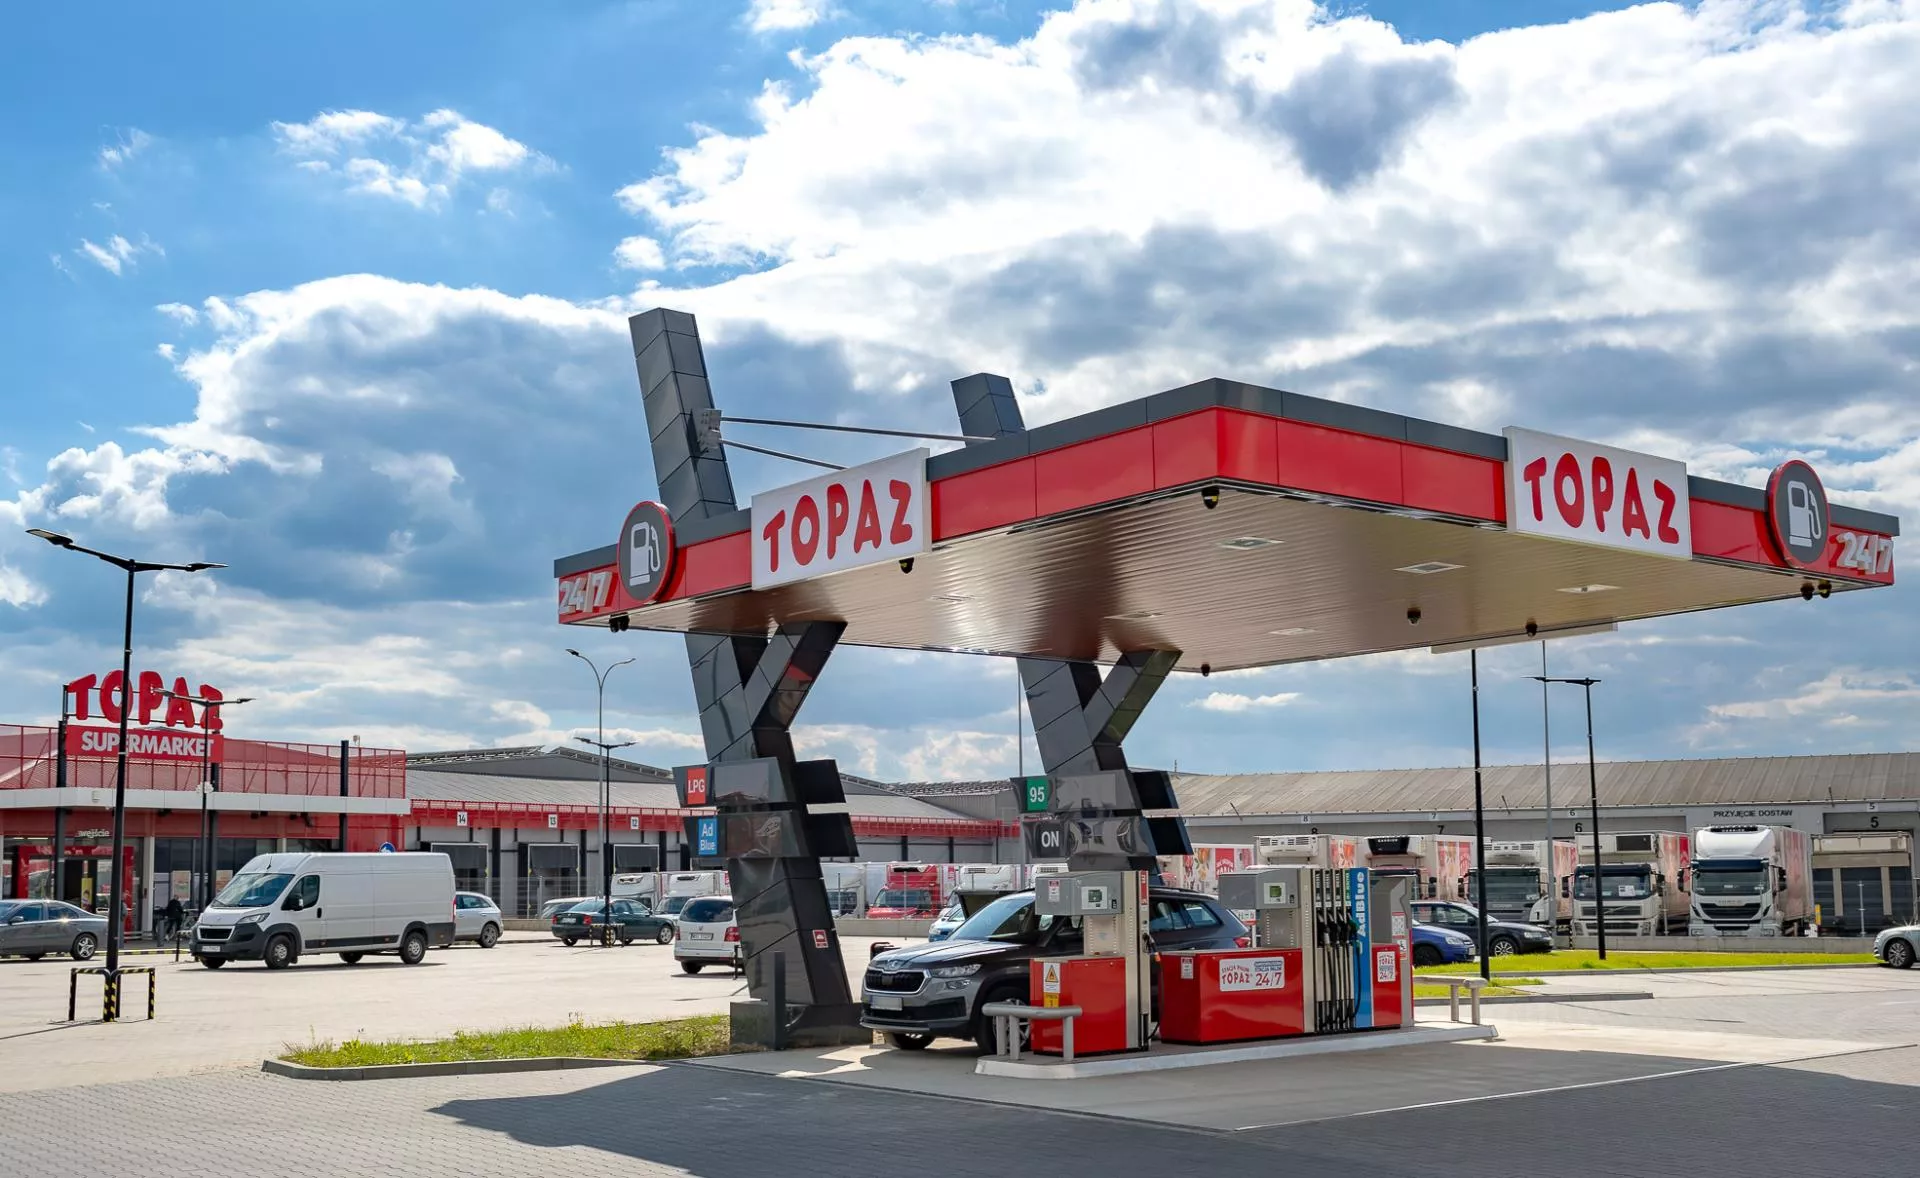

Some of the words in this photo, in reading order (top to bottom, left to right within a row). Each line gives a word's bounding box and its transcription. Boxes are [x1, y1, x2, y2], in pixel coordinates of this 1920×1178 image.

[1524, 452, 1679, 544] TOPAZ
[763, 479, 913, 573] TOPAZ
[1837, 532, 1895, 576] 24/7
[558, 571, 612, 615] 24/7
[66, 669, 224, 730] TOPAZ
[687, 779, 706, 794] LPG
[1029, 786, 1045, 803] 95
[1758, 809, 1792, 817] DOSTAW
[702, 823, 714, 837] Ad
[1437, 824, 1445, 835] 7
[1575, 822, 1583, 833] 6
[1870, 816, 1880, 829] 5
[700, 840, 717, 851] Blue
[1041, 830, 1060, 848] ON
[1355, 871, 1366, 937] AdBlue
[1221, 971, 1250, 985] TOPAZ
[1255, 972, 1282, 986] 24/7
